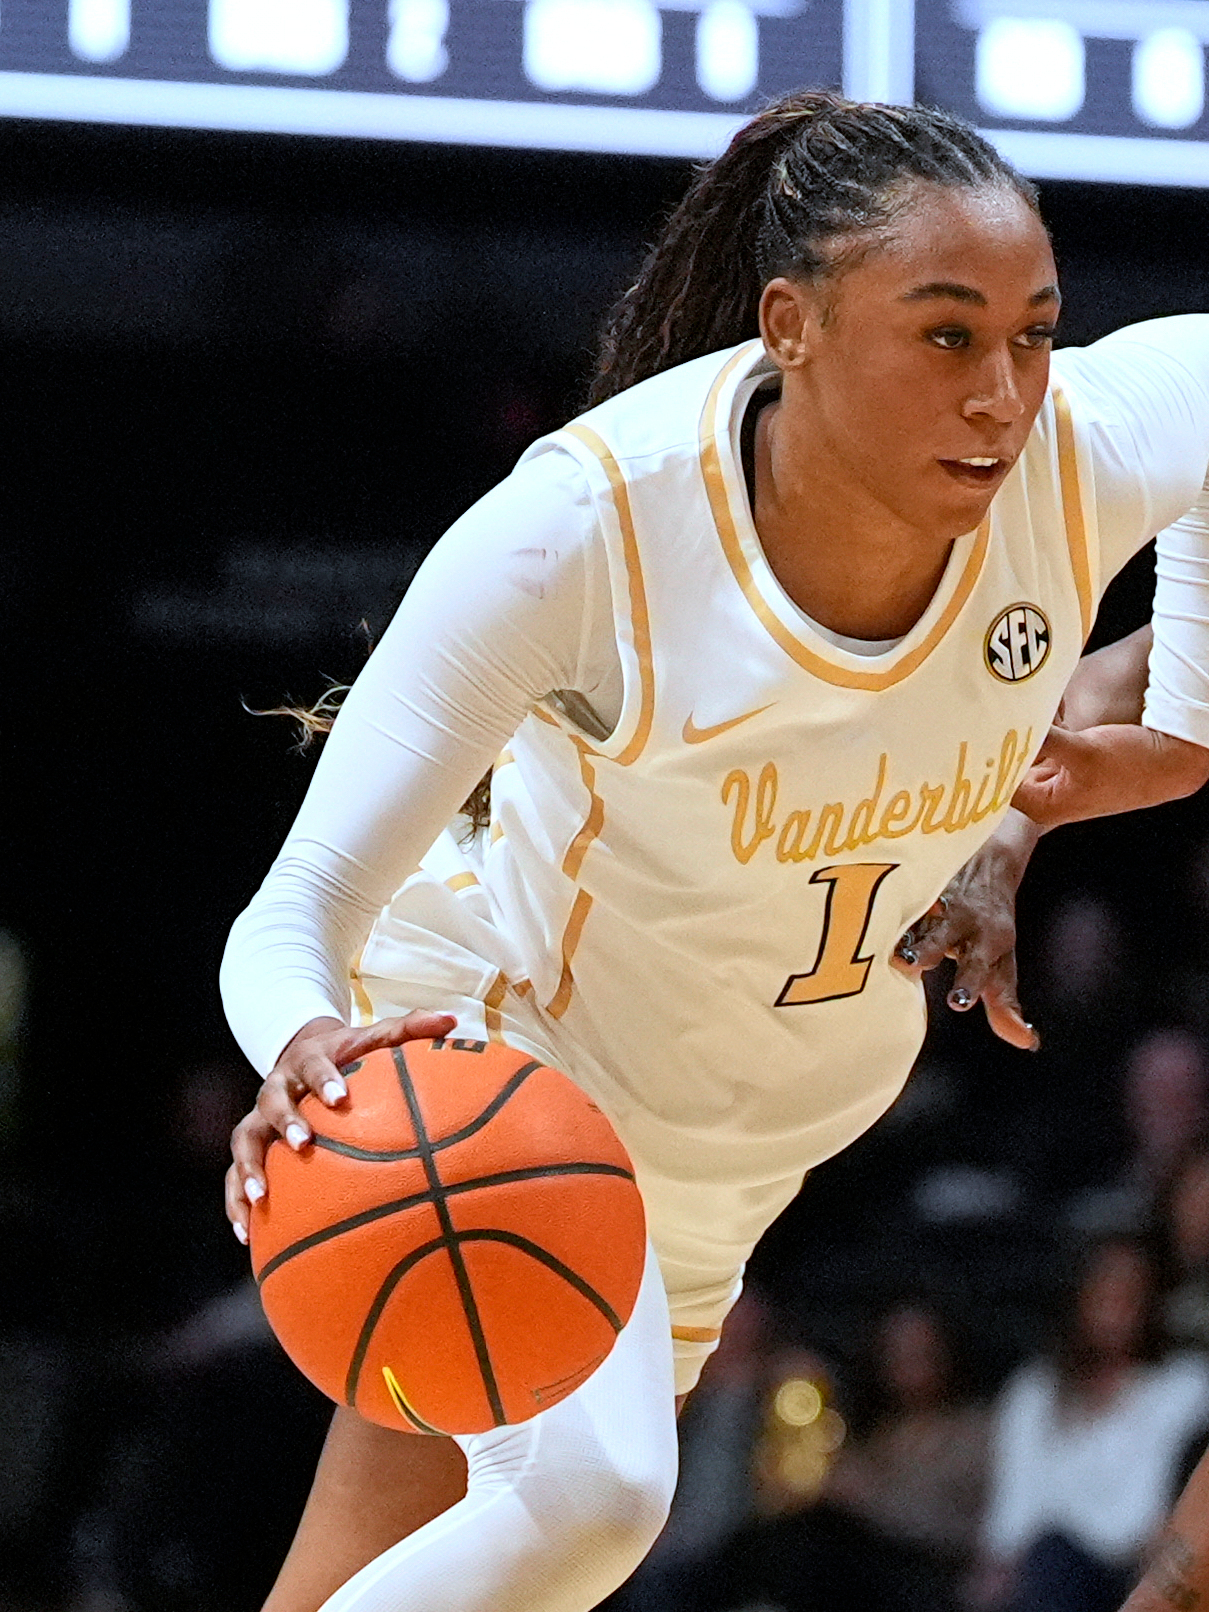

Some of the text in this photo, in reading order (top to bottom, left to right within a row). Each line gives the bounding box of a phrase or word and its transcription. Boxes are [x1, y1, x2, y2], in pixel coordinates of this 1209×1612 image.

[990, 608, 1048, 680] SEC
[720, 726, 1033, 865] Vanderbilt
[773, 862, 900, 1007] 1
